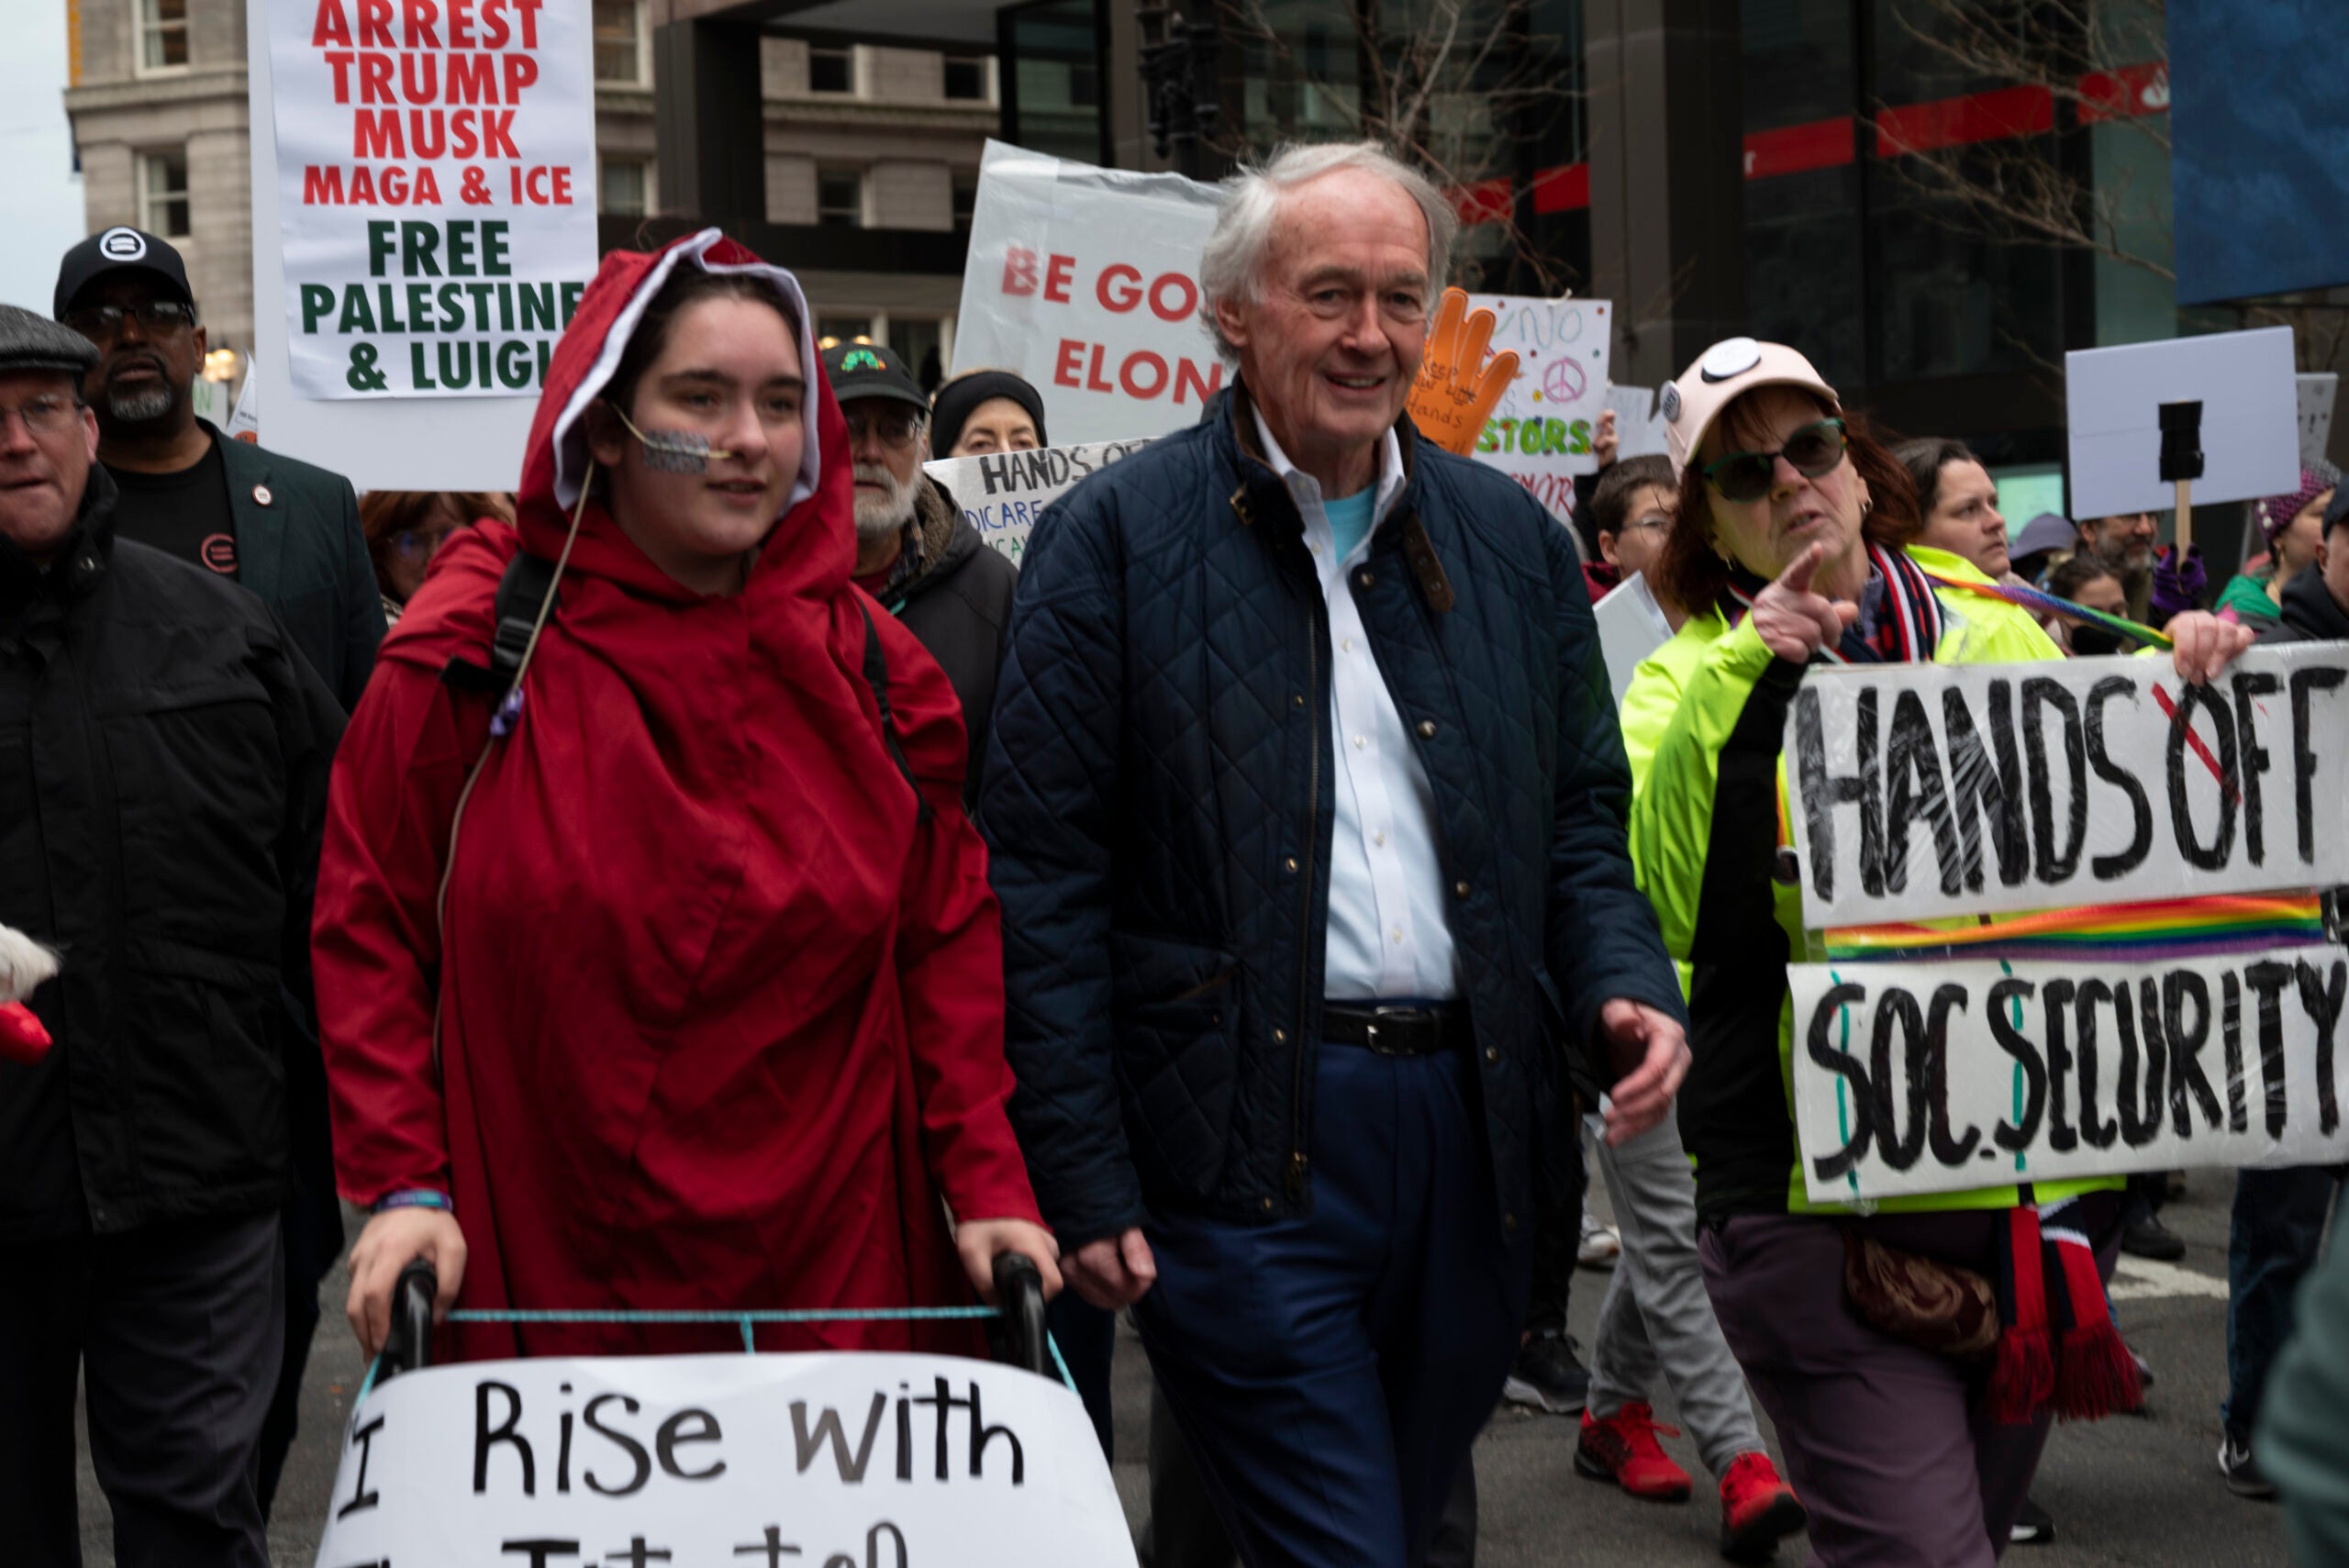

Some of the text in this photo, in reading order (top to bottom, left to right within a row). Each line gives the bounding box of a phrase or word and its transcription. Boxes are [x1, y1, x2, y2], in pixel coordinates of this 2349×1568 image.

[312, 0, 543, 50] ARREST
[324, 51, 539, 106] TRUMP
[353, 108, 521, 161] MUSK
[303, 165, 573, 206] MAGA & ICE
[367, 220, 511, 276] FREE
[1001, 246, 1208, 325] BE GO
[347, 342, 387, 391] &
[1053, 338, 1222, 405] ELON
[1475, 417, 1592, 456] STORS
[979, 446, 1094, 495] HANDS
[964, 499, 1042, 533] DICARE
[1795, 666, 2348, 903] HANDS OFF
[788, 1374, 1025, 1487] with
